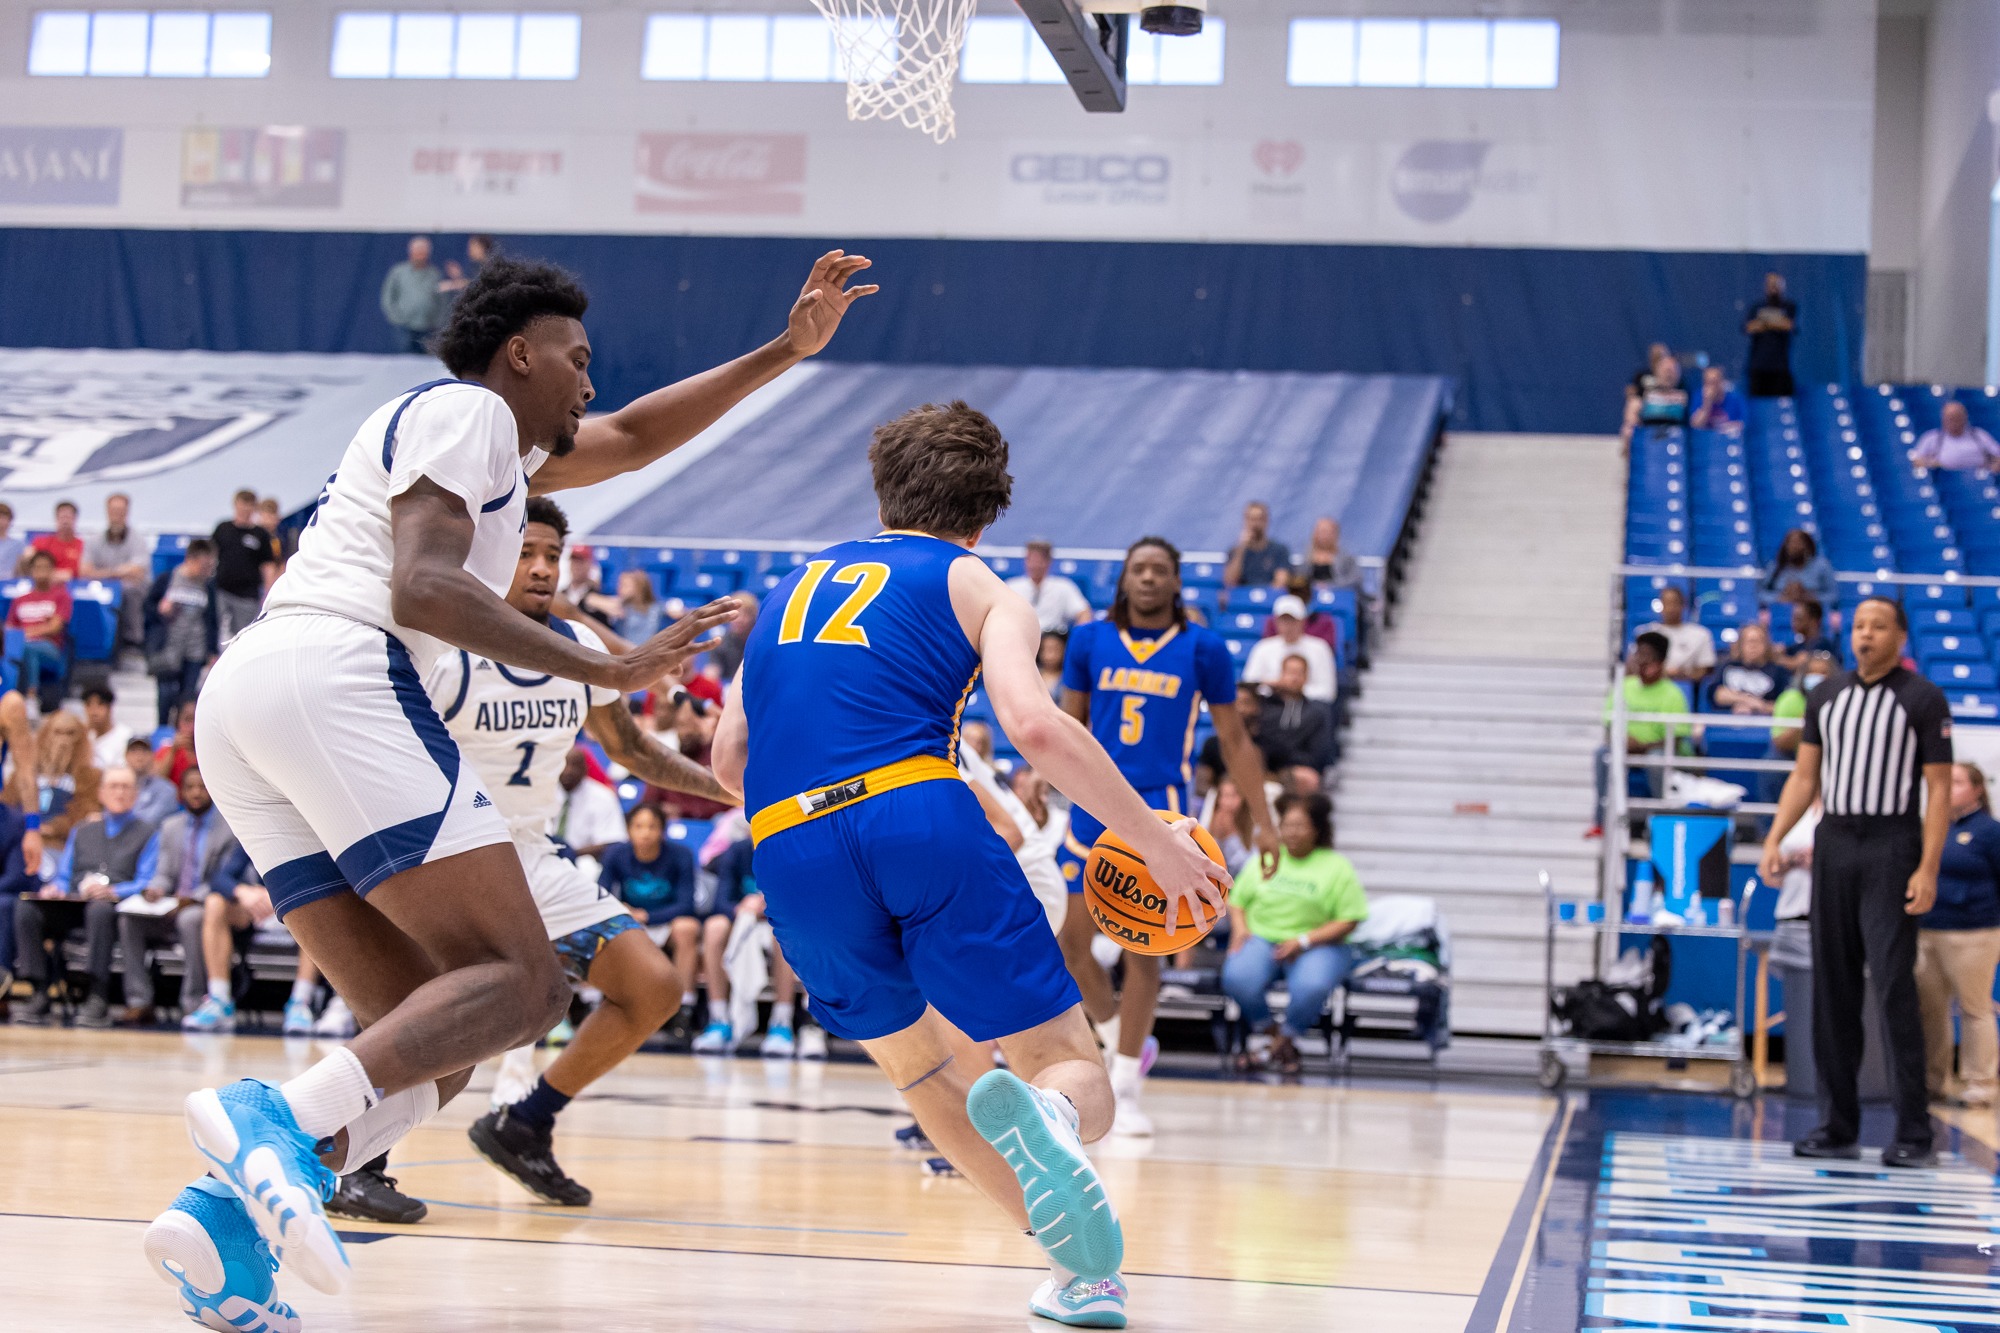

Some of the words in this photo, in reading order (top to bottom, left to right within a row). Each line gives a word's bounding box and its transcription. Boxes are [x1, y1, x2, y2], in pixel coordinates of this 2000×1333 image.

[1010, 154, 1170, 182] GEICO
[778, 560, 891, 648] 12
[475, 699, 579, 731] AUGUSTA
[1119, 694, 1147, 746] 5
[505, 740, 539, 787] 1
[1092, 905, 1150, 946] NCAA
